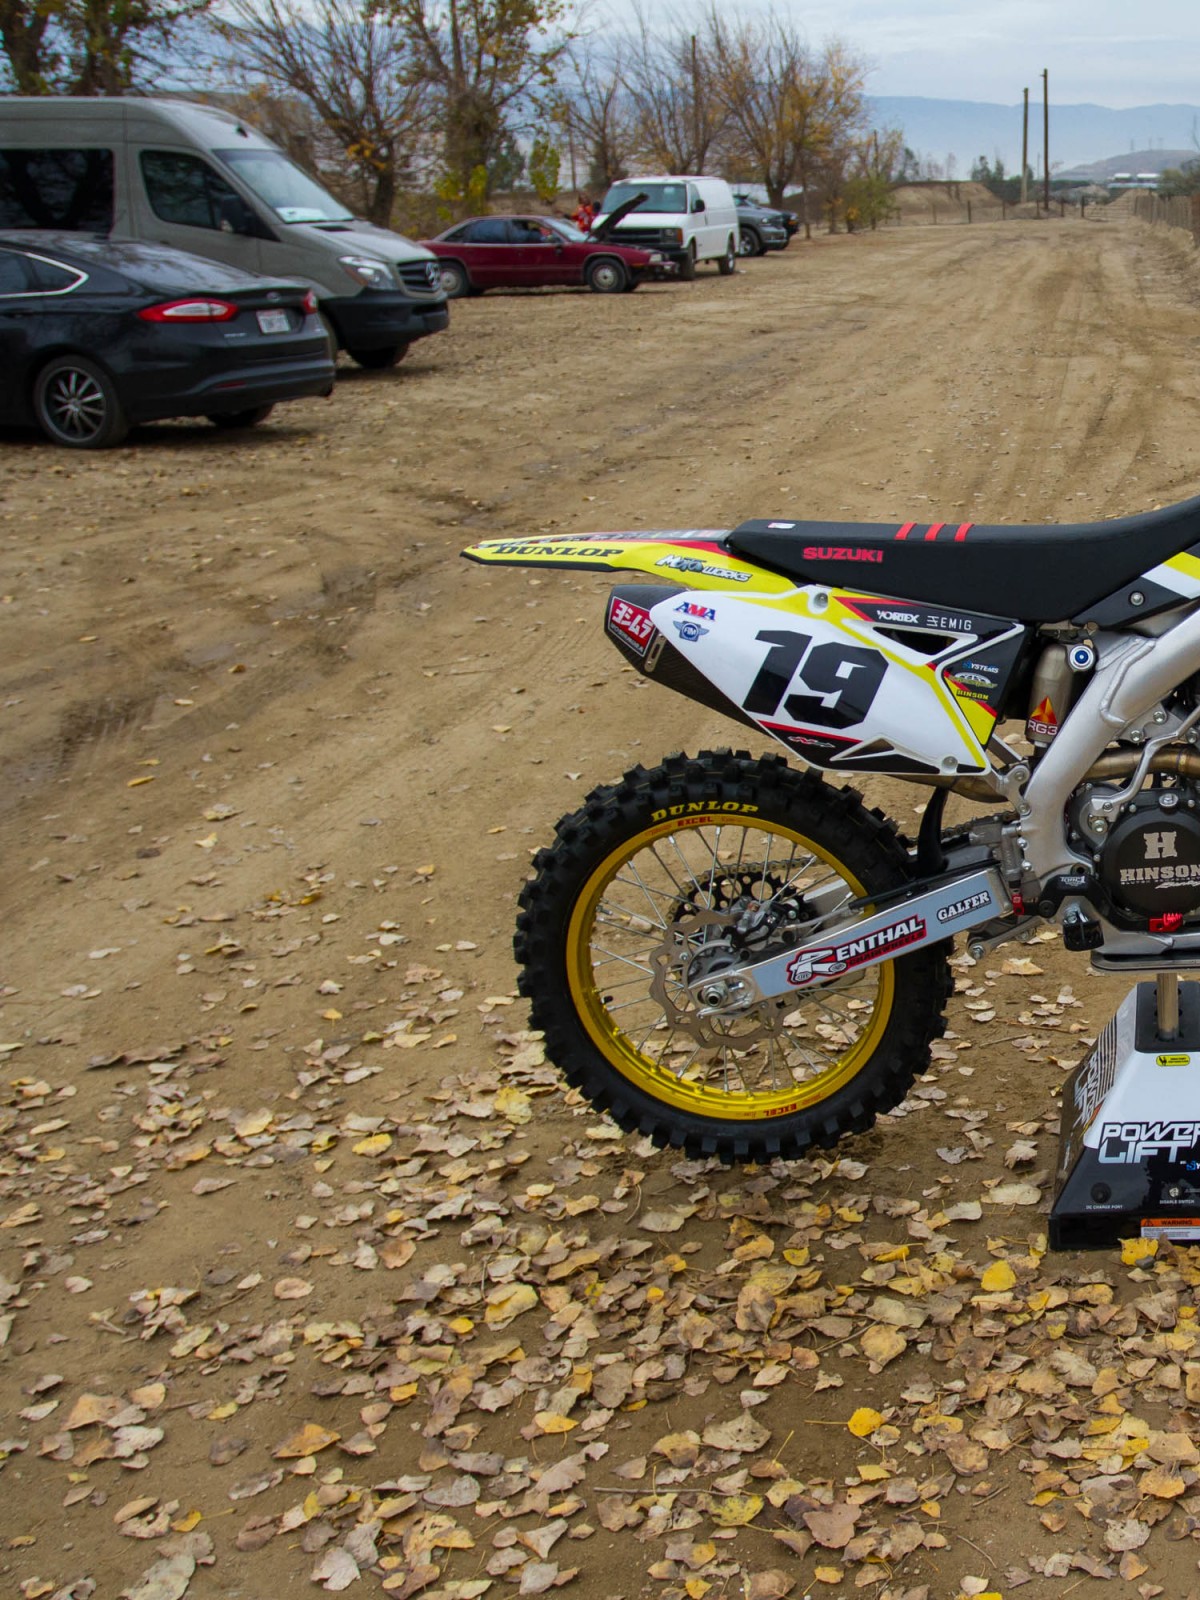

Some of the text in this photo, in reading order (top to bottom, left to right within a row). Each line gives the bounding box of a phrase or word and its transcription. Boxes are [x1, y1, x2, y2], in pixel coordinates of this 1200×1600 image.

[492, 545, 624, 557] DUNLOP
[802, 547, 884, 563] SUZUKI
[612, 602, 654, 639] ヨシムラ
[674, 601, 716, 621] AMA
[876, 610, 972, 631] VORTEX EMIG
[742, 630, 889, 730] 19
[957, 690, 989, 700] HINSON
[1028, 719, 1058, 736] RG3
[651, 801, 759, 822] DUNLOP
[1143, 831, 1178, 859] H
[937, 891, 990, 921] GALFER
[790, 919, 924, 982] RENTHAL
[1099, 1140, 1192, 1163] LIFT
